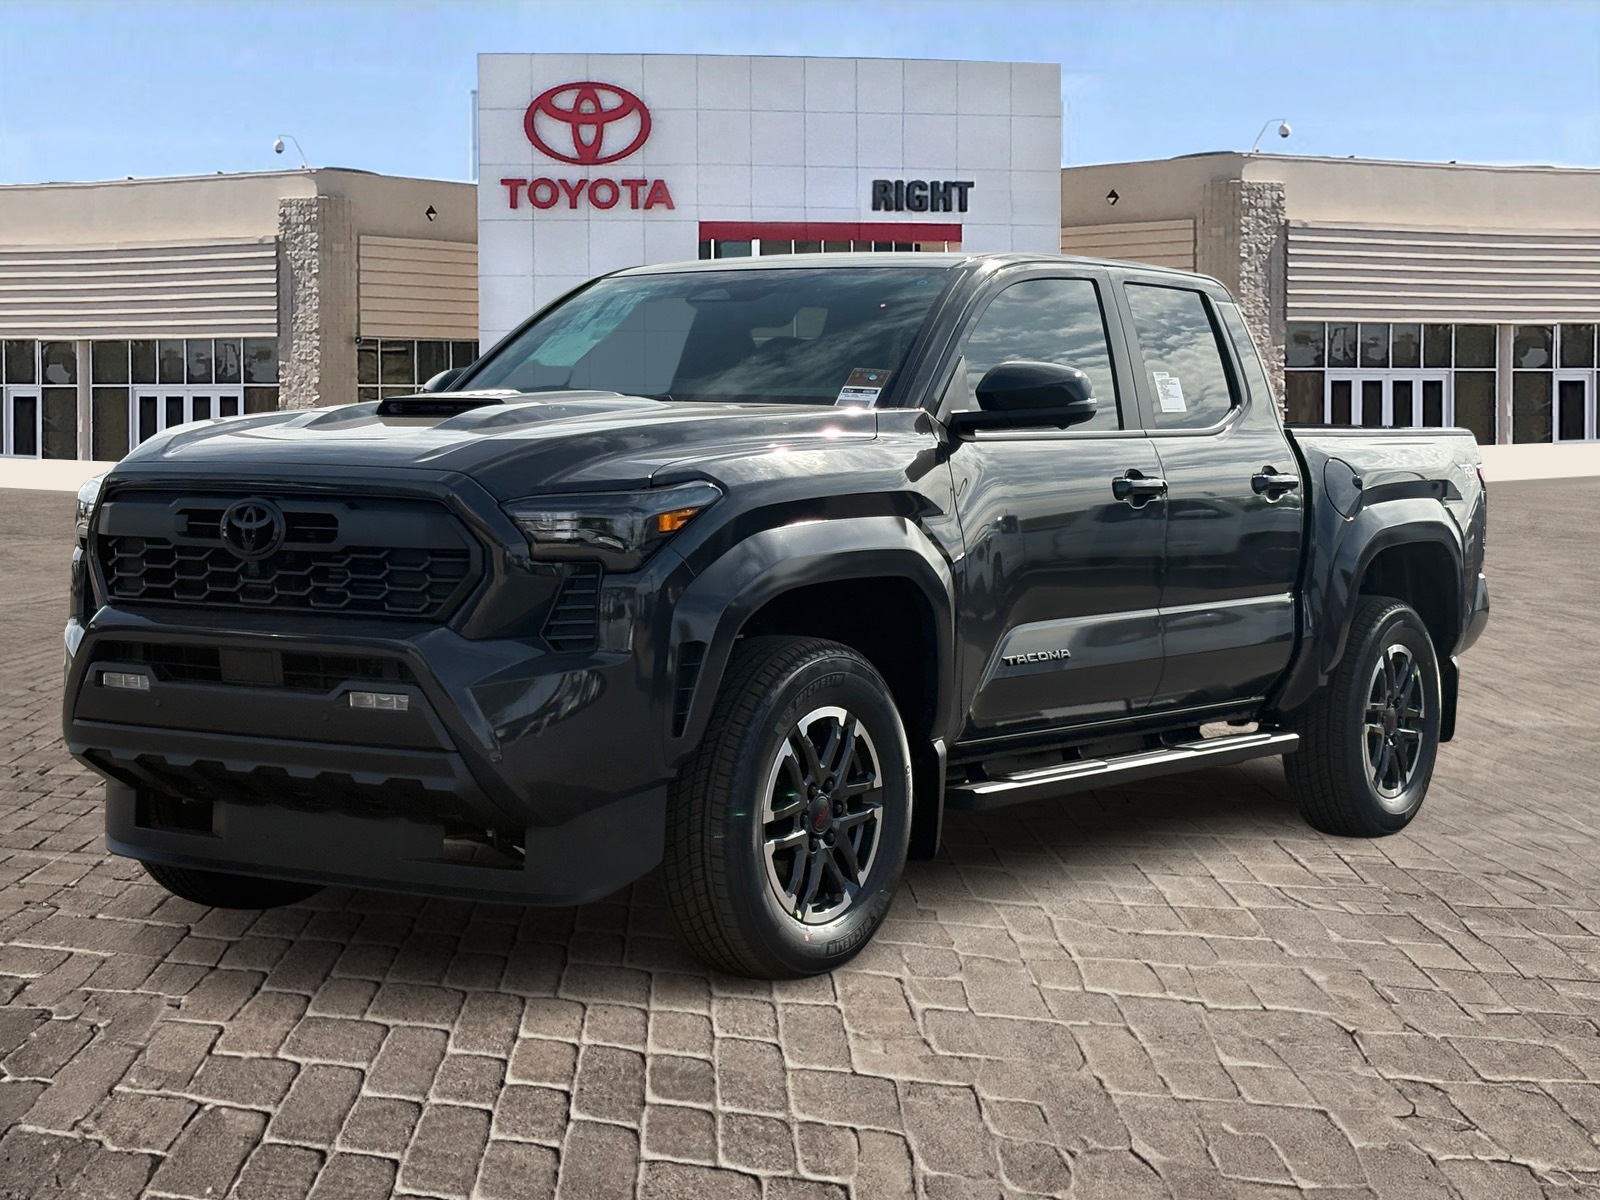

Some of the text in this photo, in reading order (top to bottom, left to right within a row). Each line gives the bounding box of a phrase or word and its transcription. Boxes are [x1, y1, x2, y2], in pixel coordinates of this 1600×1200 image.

[500, 178, 675, 210] TOYOTA
[871, 178, 975, 213] RIGHT
[1002, 649, 1071, 666] TACOMA
[795, 674, 843, 709] MICHELIN
[828, 916, 873, 955] MICHELIN
